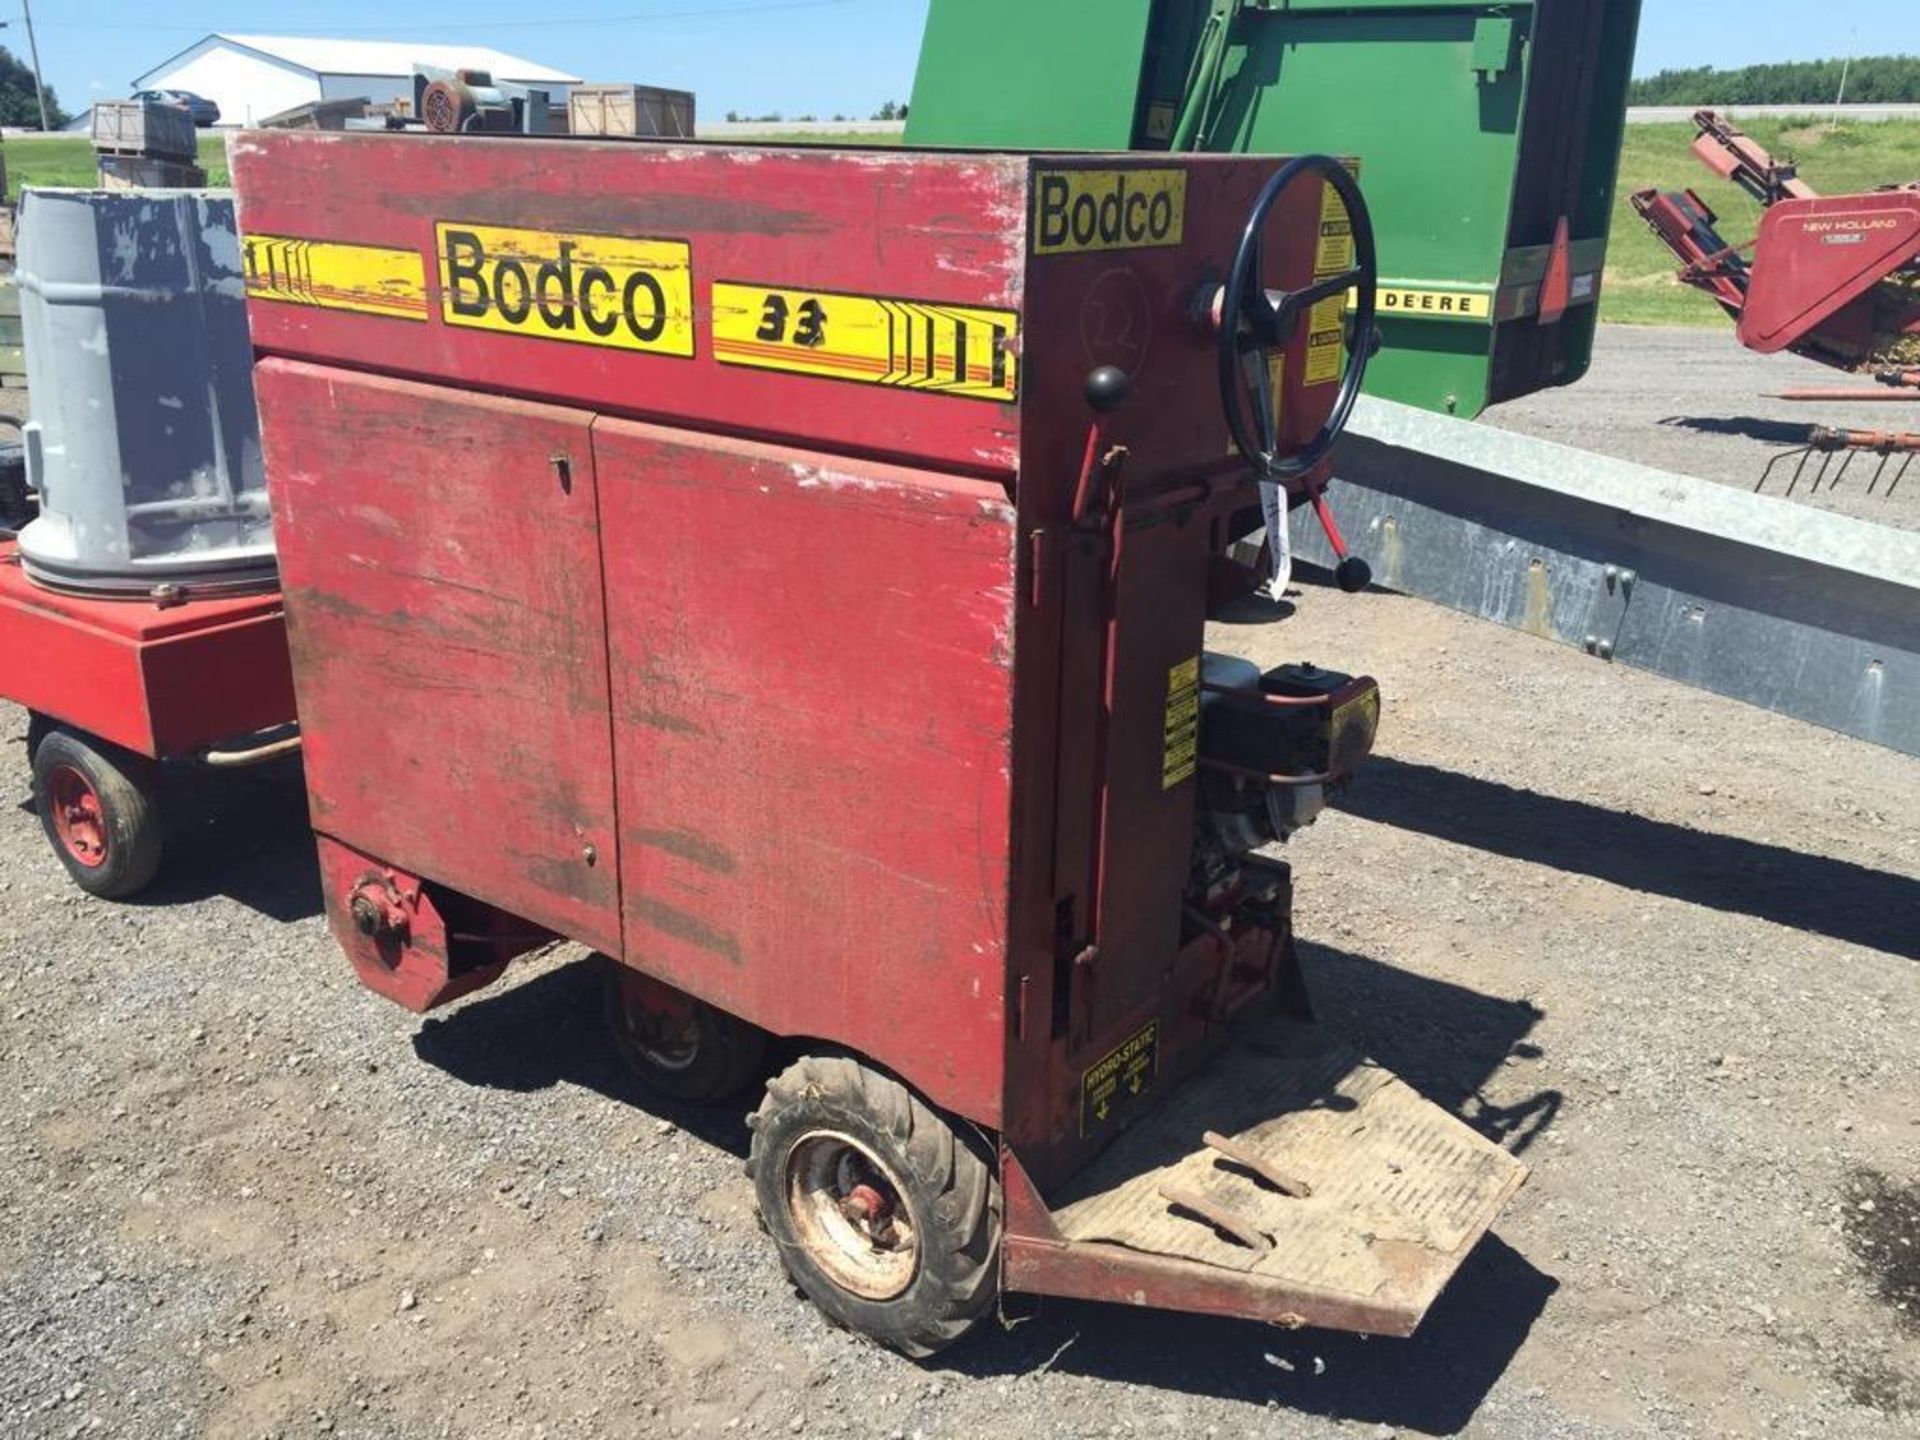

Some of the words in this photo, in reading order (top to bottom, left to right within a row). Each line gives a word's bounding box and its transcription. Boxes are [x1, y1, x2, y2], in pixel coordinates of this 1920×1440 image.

[1041, 175, 1173, 247] Bodco
[1803, 221, 1832, 232] NEW
[1835, 219, 1897, 231] HOLLAND
[446, 230, 666, 342] Bodco
[1385, 292, 1471, 312] DEERE
[756, 294, 827, 347] 33
